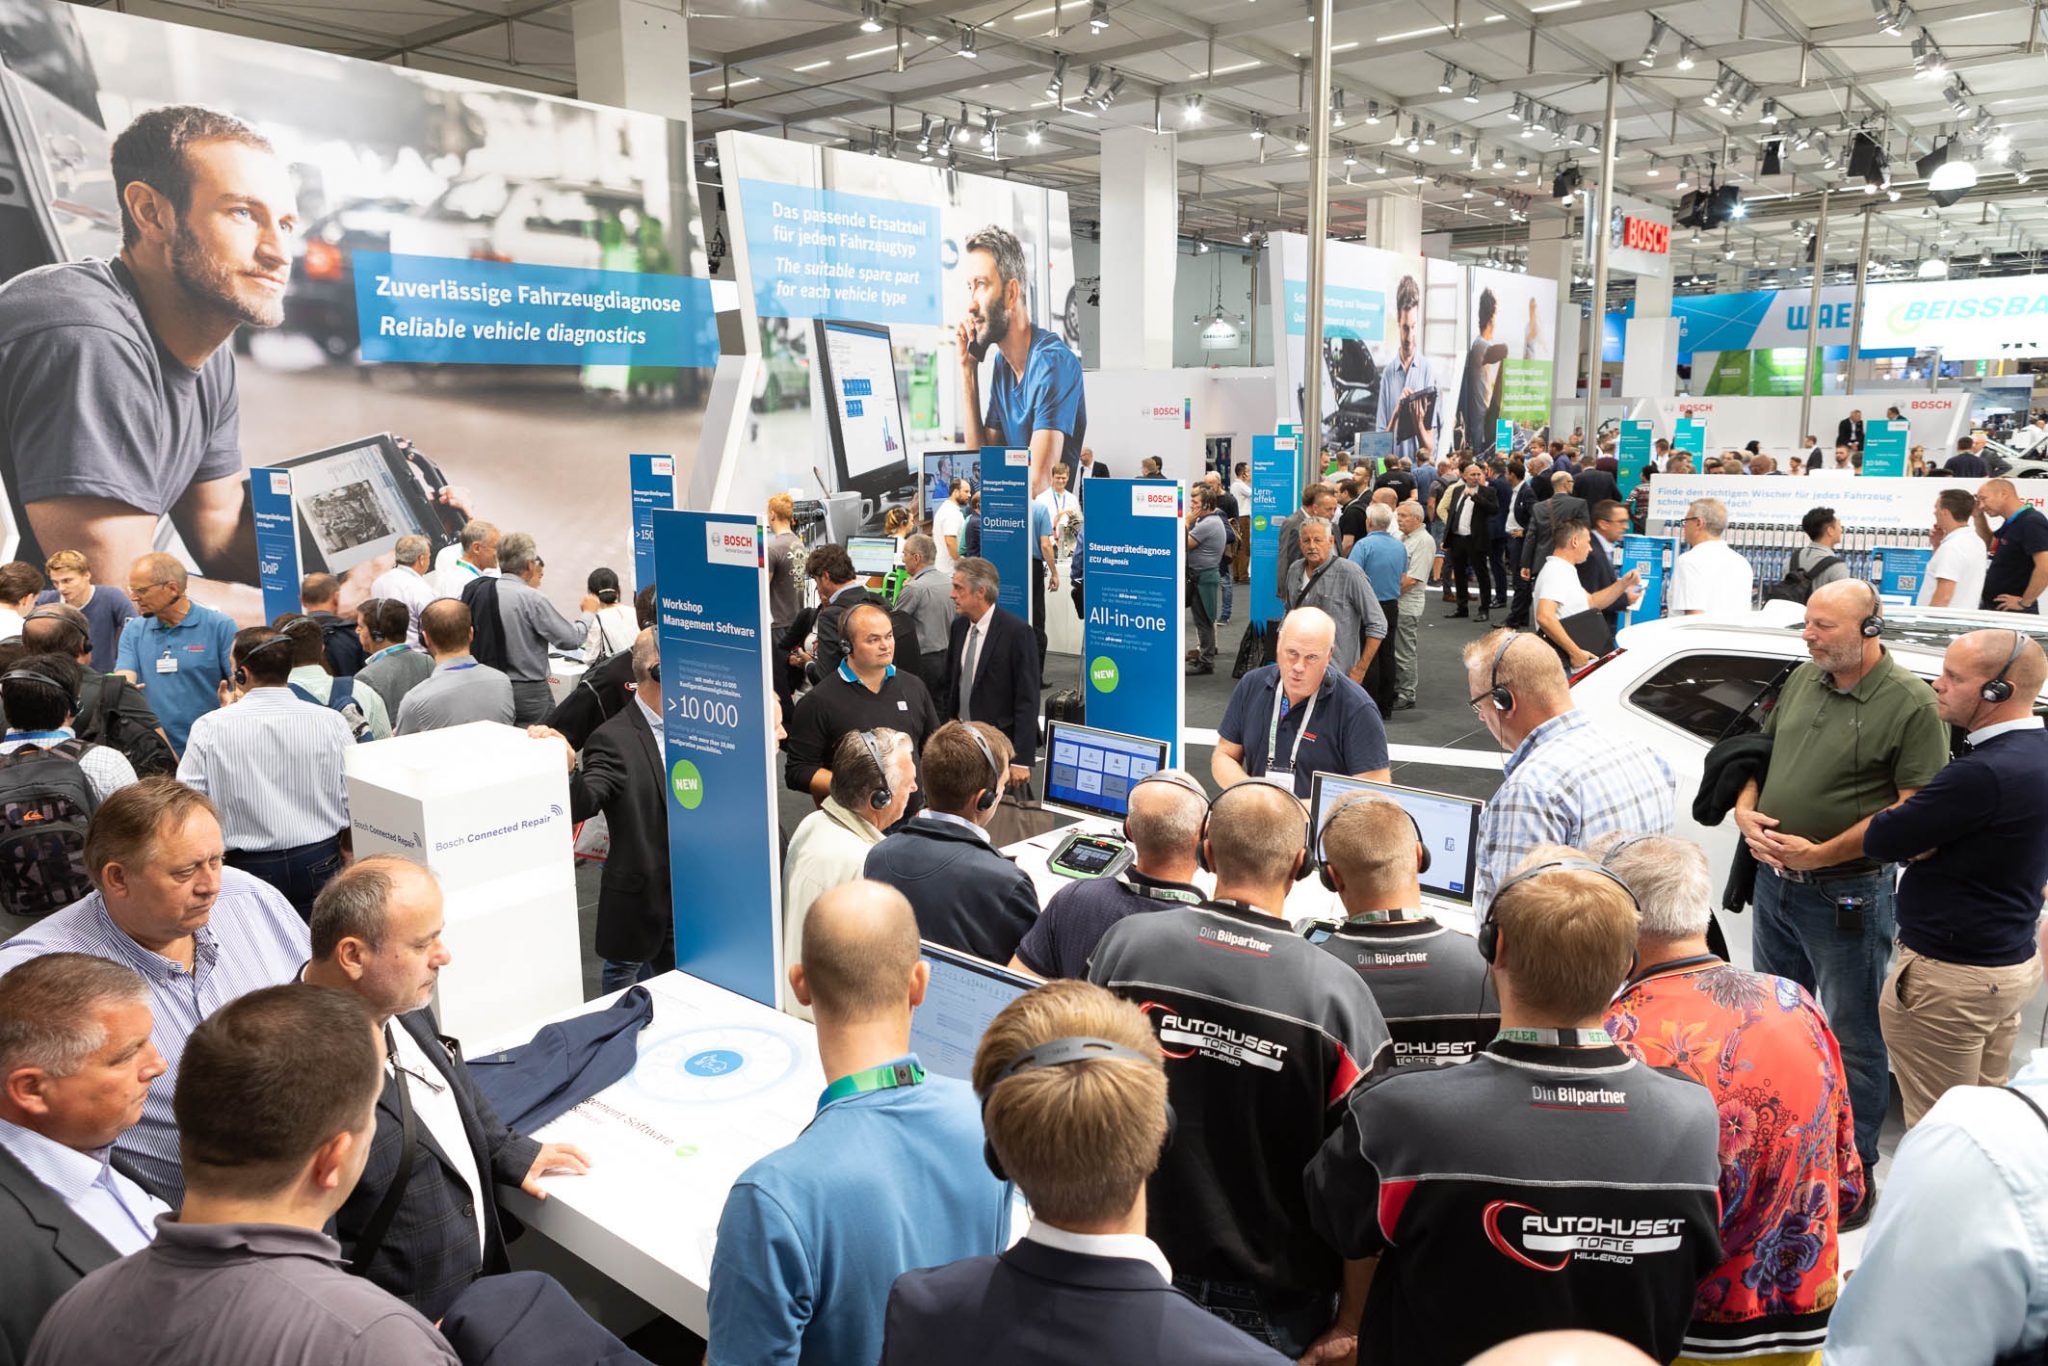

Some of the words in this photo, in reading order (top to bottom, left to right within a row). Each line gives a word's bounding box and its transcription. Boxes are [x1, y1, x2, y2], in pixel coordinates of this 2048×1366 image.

[772, 201, 799, 220] Das
[803, 208, 865, 228] passende
[869, 213, 926, 236] Ersatzteil
[773, 225, 795, 243] für
[798, 229, 836, 248] jeden
[840, 233, 916, 257] Fahrzeugtyp
[1625, 216, 1671, 254] BOSCH
[776, 257, 801, 275] The
[804, 260, 855, 279] suitable
[858, 268, 892, 284] spare
[895, 270, 920, 285] part
[375, 275, 512, 306] Zuverlässige
[518, 285, 681, 314] Fahrzeugdiagnose
[776, 280, 797, 298] for
[800, 283, 831, 300] each
[834, 286, 878, 303] vehicle
[881, 289, 907, 306] type
[1787, 303, 1865, 330] WAE
[1904, 293, 2048, 321] BEISSBA
[380, 316, 466, 339] Reliable
[473, 321, 540, 342] vehicle
[547, 324, 646, 347] diagnostics
[1153, 407, 1180, 416] BOSCH
[1911, 401, 1952, 409] BOSCH
[1147, 494, 1173, 503] BOSCH
[1254, 495, 1276, 504] effekt
[1658, 488, 1684, 496] Finde
[1686, 488, 1703, 496] den
[1706, 488, 1749, 498] richtigen
[1752, 489, 1791, 498] Wischer
[1813, 490, 1840, 500] jedes
[1844, 491, 1893, 502] Fahrzeug
[983, 517, 1025, 528] Optimiert
[724, 535, 752, 547] BOSCH
[1088, 542, 1171, 556] Steuergerätediagnose
[662, 597, 703, 614] Workshop
[663, 614, 714, 631] Management
[716, 622, 755, 637] Software
[1089, 607, 1166, 631] All-in-one
[1094, 669, 1114, 680] NEW
[675, 778, 698, 790] NEW
[354, 819, 368, 832] Bosch
[369, 824, 397, 843] Connected
[397, 834, 415, 848] Repair
[436, 838, 465, 852] Bosch
[468, 822, 518, 843] Connected
[522, 814, 551, 829] Repair
[1216, 929, 1272, 952] Bilpartner
[1375, 952, 1428, 966] Bilpartner
[1161, 1014, 1288, 1059] AUTOHUSET
[1202, 1036, 1243, 1058] TOFTE
[1199, 1048, 1241, 1067] HILLERØD
[1394, 1041, 1477, 1054] OHUSET
[1557, 1086, 1627, 1105] Bilpartner
[623, 1117, 674, 1145] Software
[1522, 1215, 1685, 1236] AUTOHUSET
[1577, 1236, 1634, 1252] TOFTE
[1574, 1251, 1634, 1264] HILLERØD
